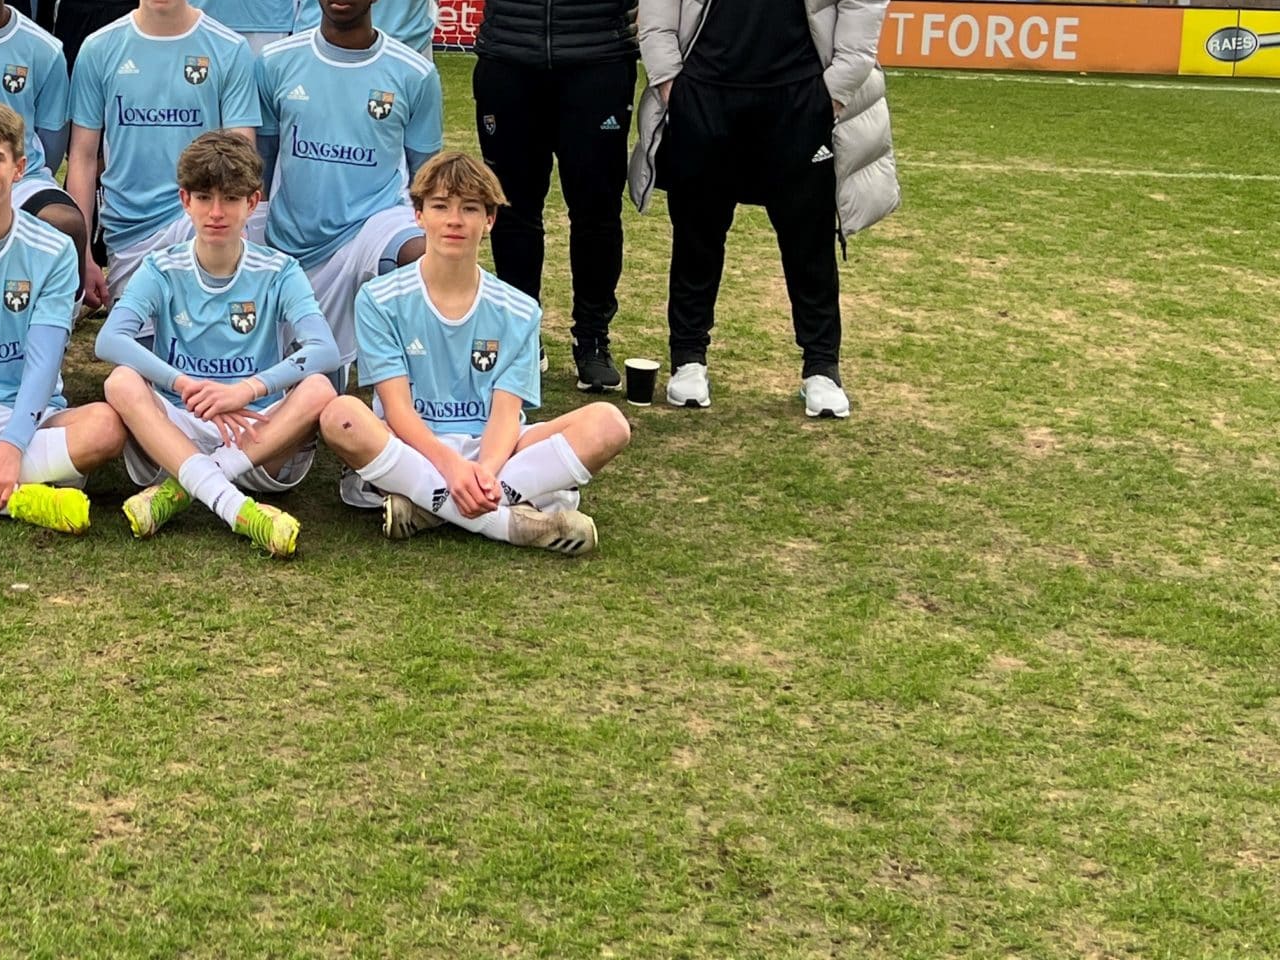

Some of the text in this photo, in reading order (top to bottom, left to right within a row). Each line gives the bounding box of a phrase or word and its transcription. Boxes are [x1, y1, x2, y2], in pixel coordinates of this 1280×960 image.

[1210, 36, 1253, 52] RAES
[115, 95, 204, 128] LONGSHOT
[291, 125, 378, 167] LONGSHOT
[167, 337, 259, 379] LONGSHOT
